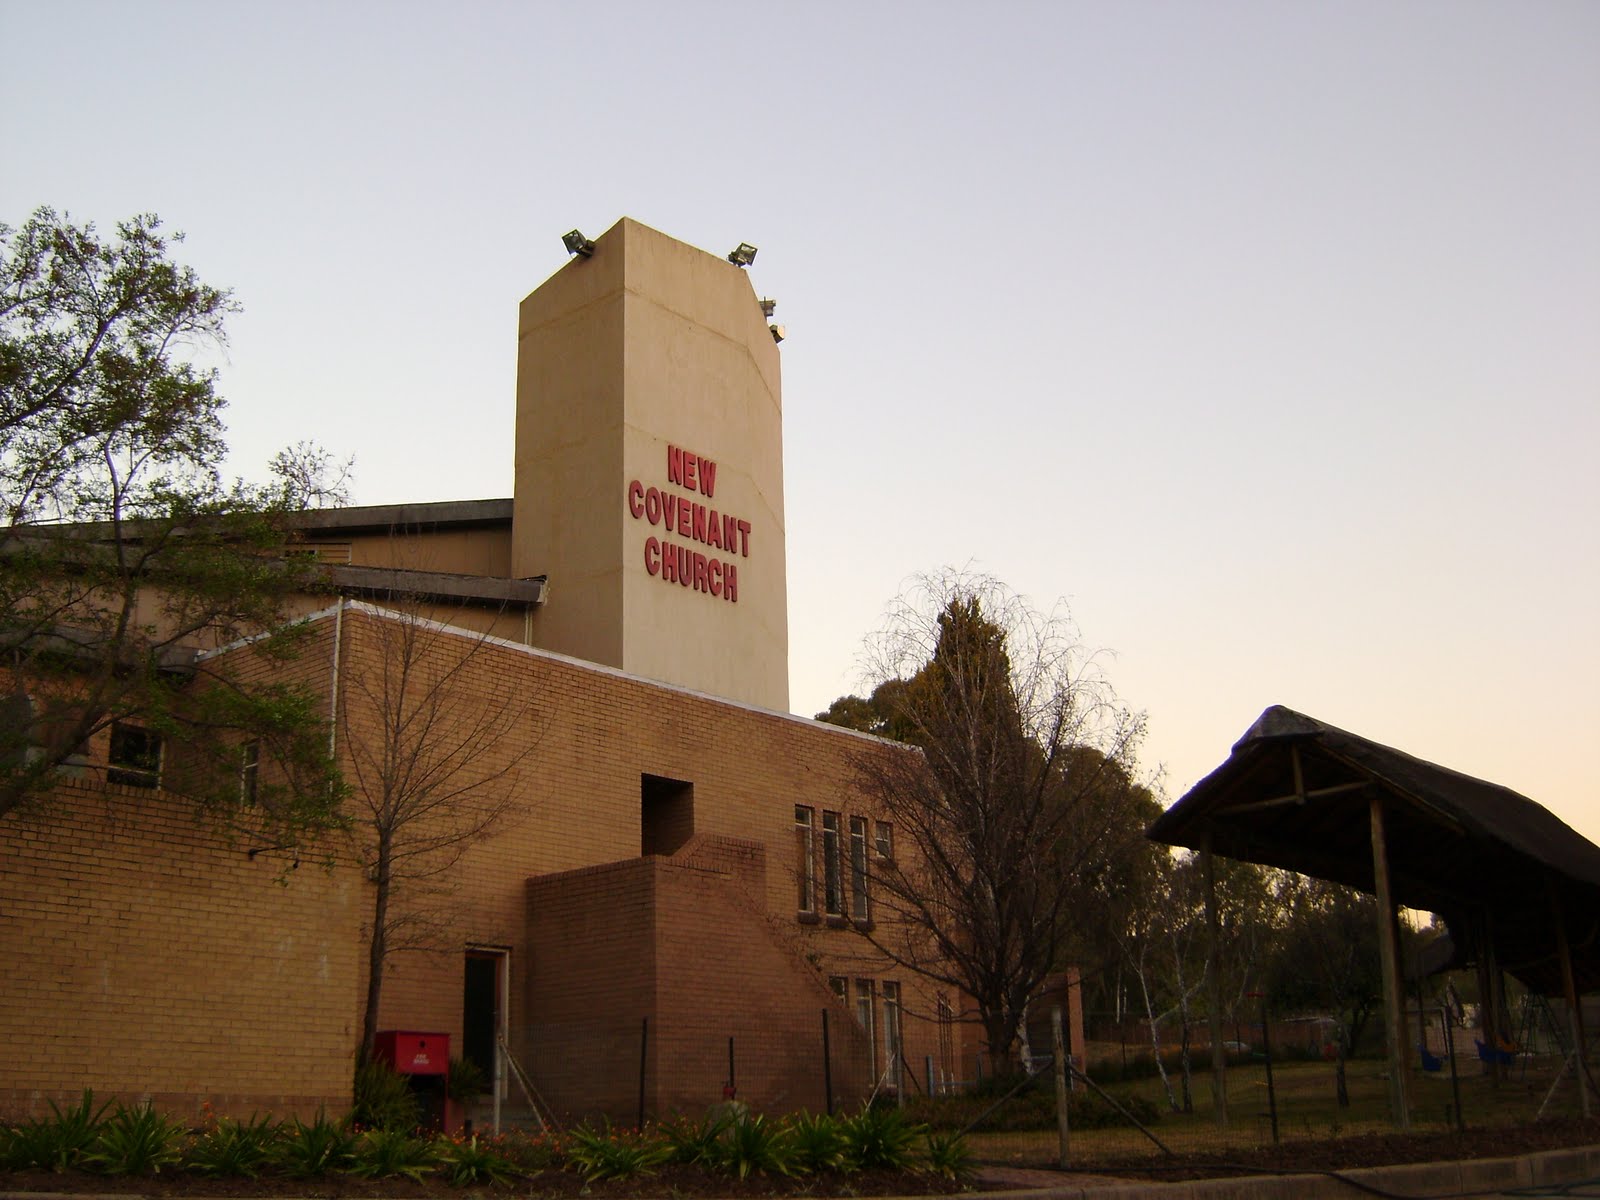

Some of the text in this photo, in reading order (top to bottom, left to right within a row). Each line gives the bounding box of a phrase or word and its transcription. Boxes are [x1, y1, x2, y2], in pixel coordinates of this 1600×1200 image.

[668, 445, 717, 498] NEW
[629, 480, 751, 557] COVENANT
[645, 536, 738, 602] CHURCH
